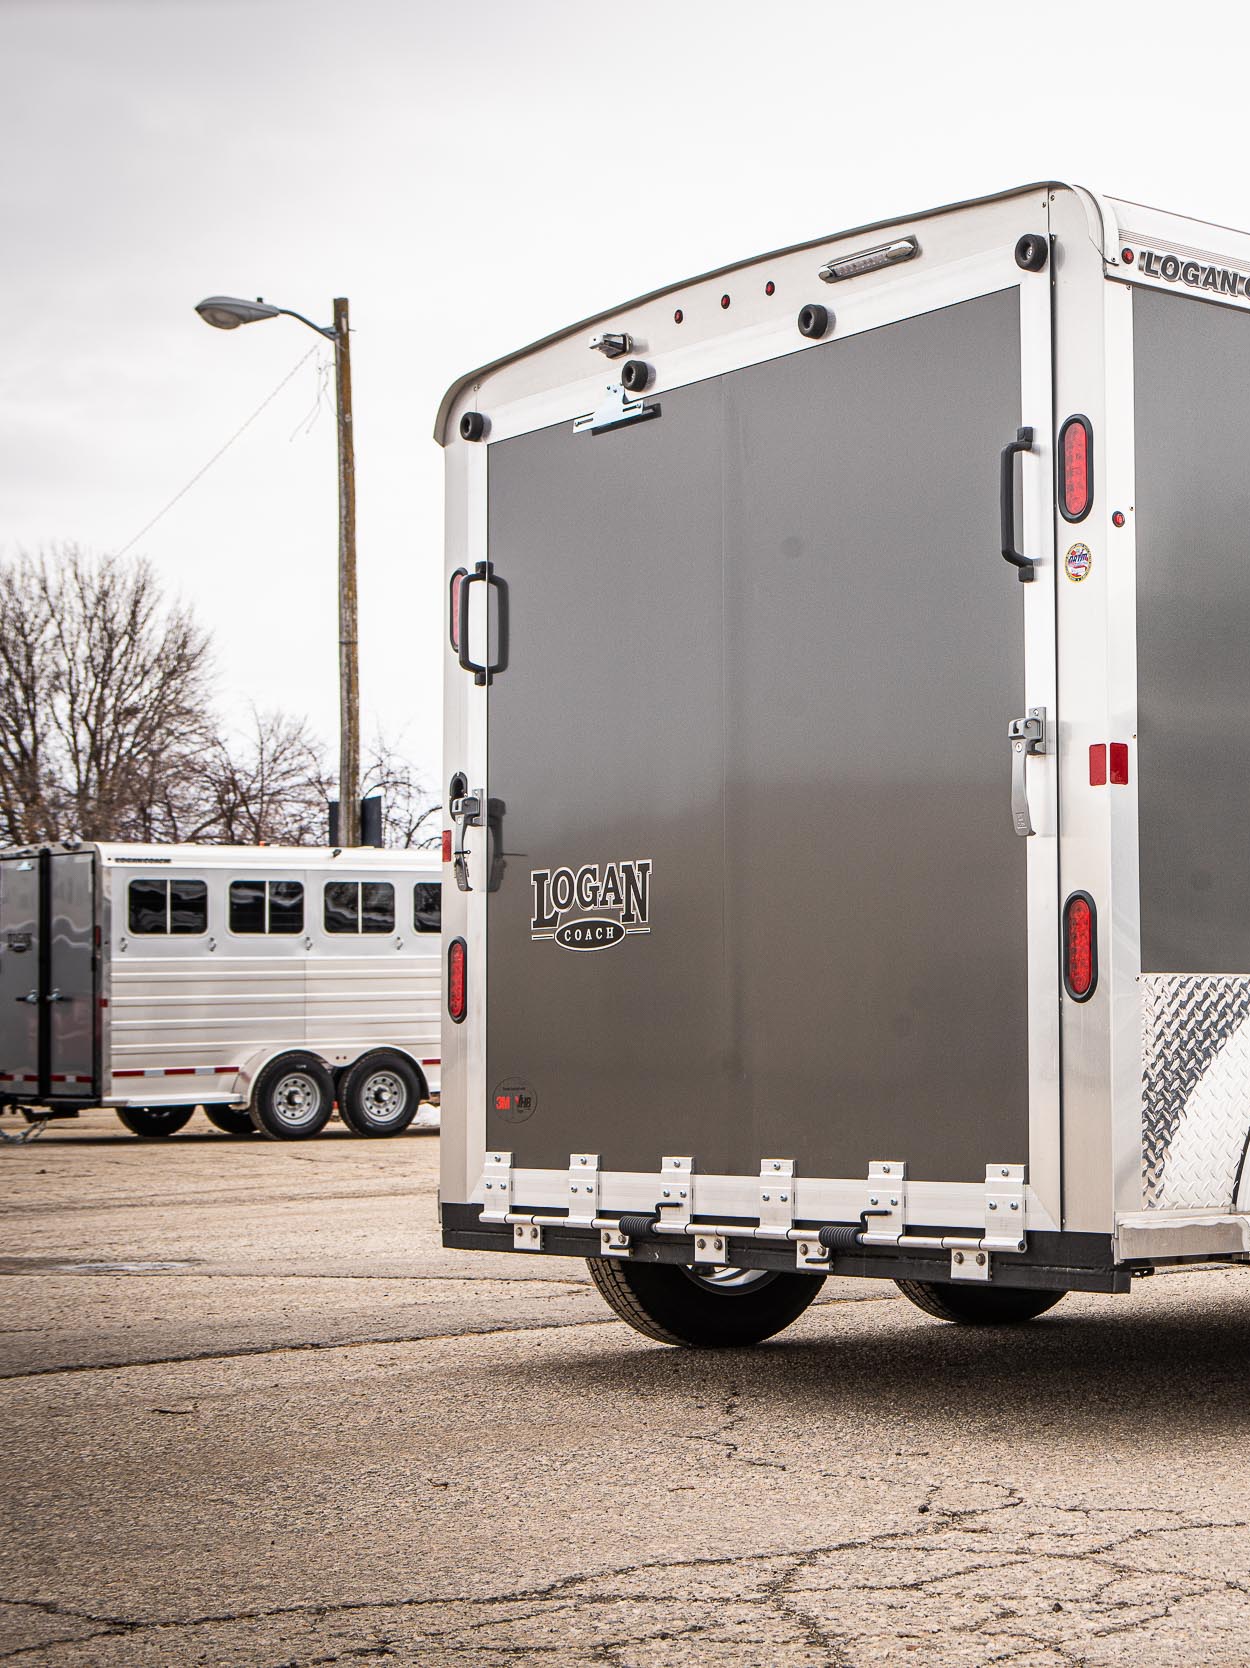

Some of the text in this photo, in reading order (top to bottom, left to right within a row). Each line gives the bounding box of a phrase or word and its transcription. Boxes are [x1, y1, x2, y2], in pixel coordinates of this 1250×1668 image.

[1144, 250, 1239, 297] LOGAN
[530, 858, 653, 931] LOGAN
[564, 926, 615, 942] COACH
[495, 1095, 511, 1110] 3M
